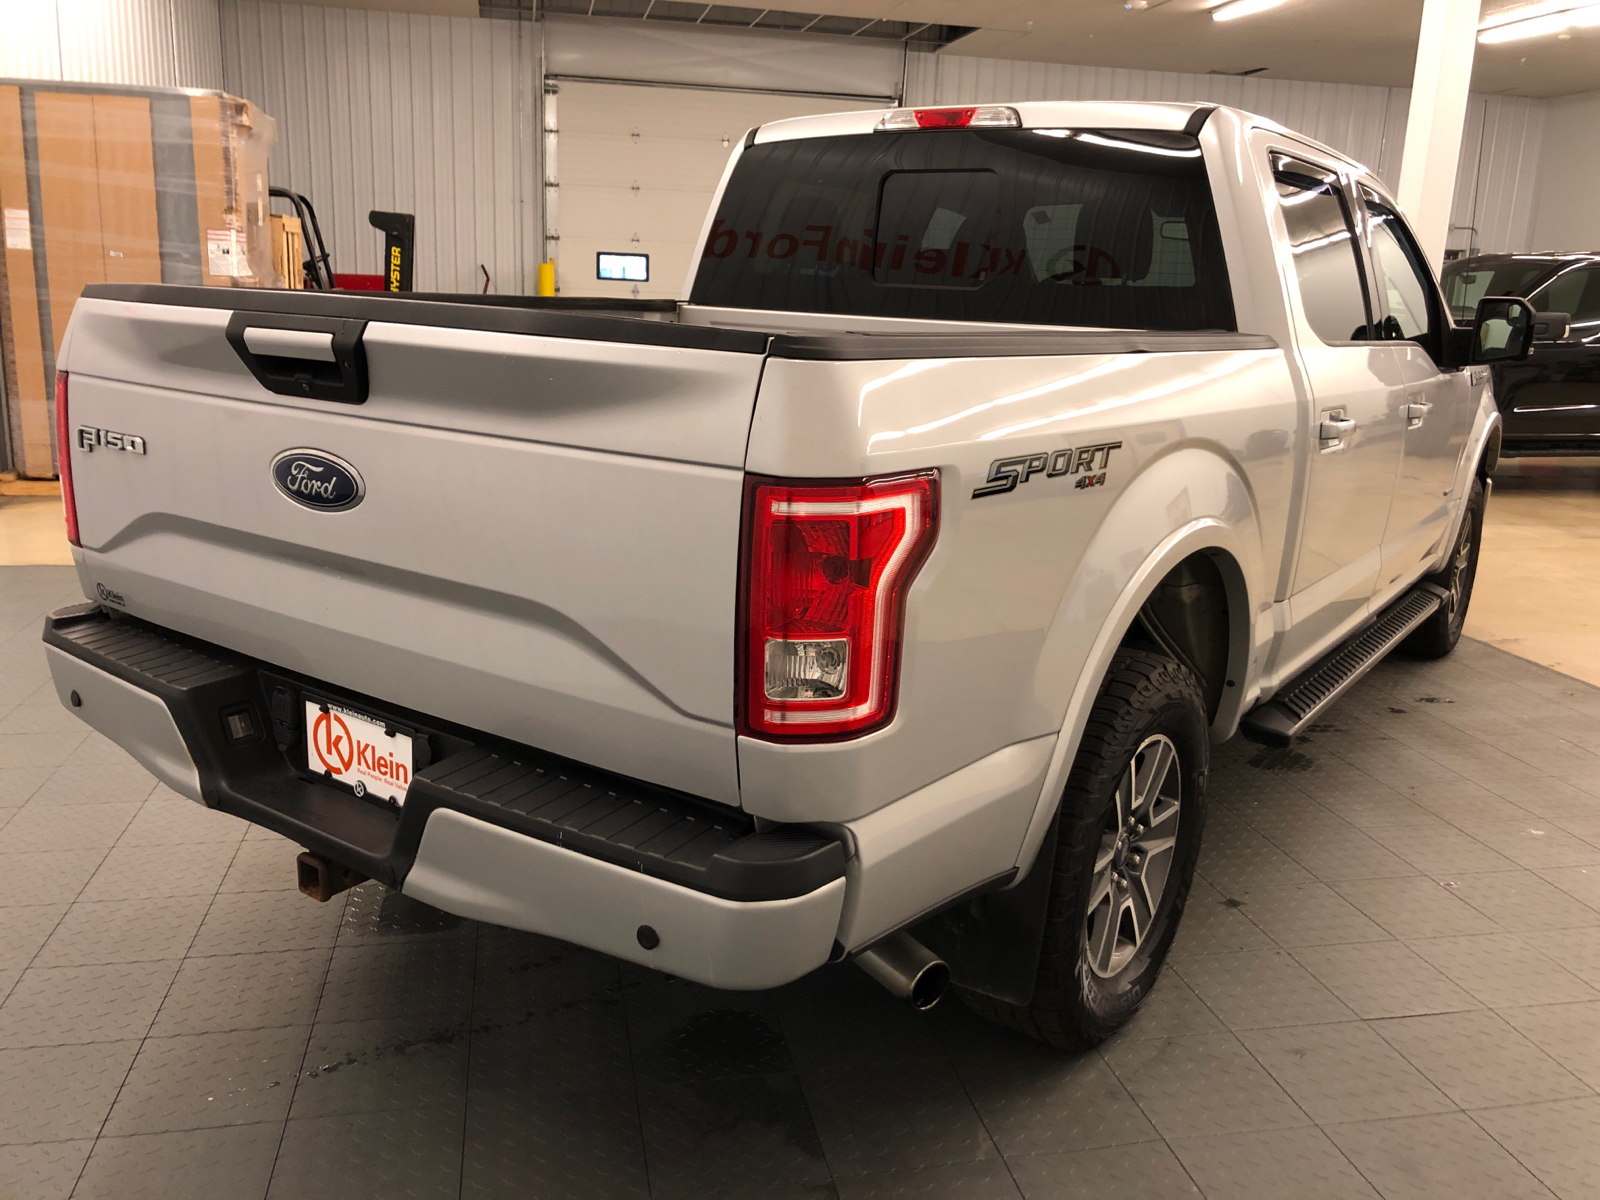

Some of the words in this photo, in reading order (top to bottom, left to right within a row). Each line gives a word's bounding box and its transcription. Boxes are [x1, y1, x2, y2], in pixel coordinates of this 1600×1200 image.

[287, 460, 337, 500] Ford
[971, 441, 1123, 500] SPORT
[327, 703, 386, 729] www.kleinauto.com
[356, 739, 409, 785] Klein
